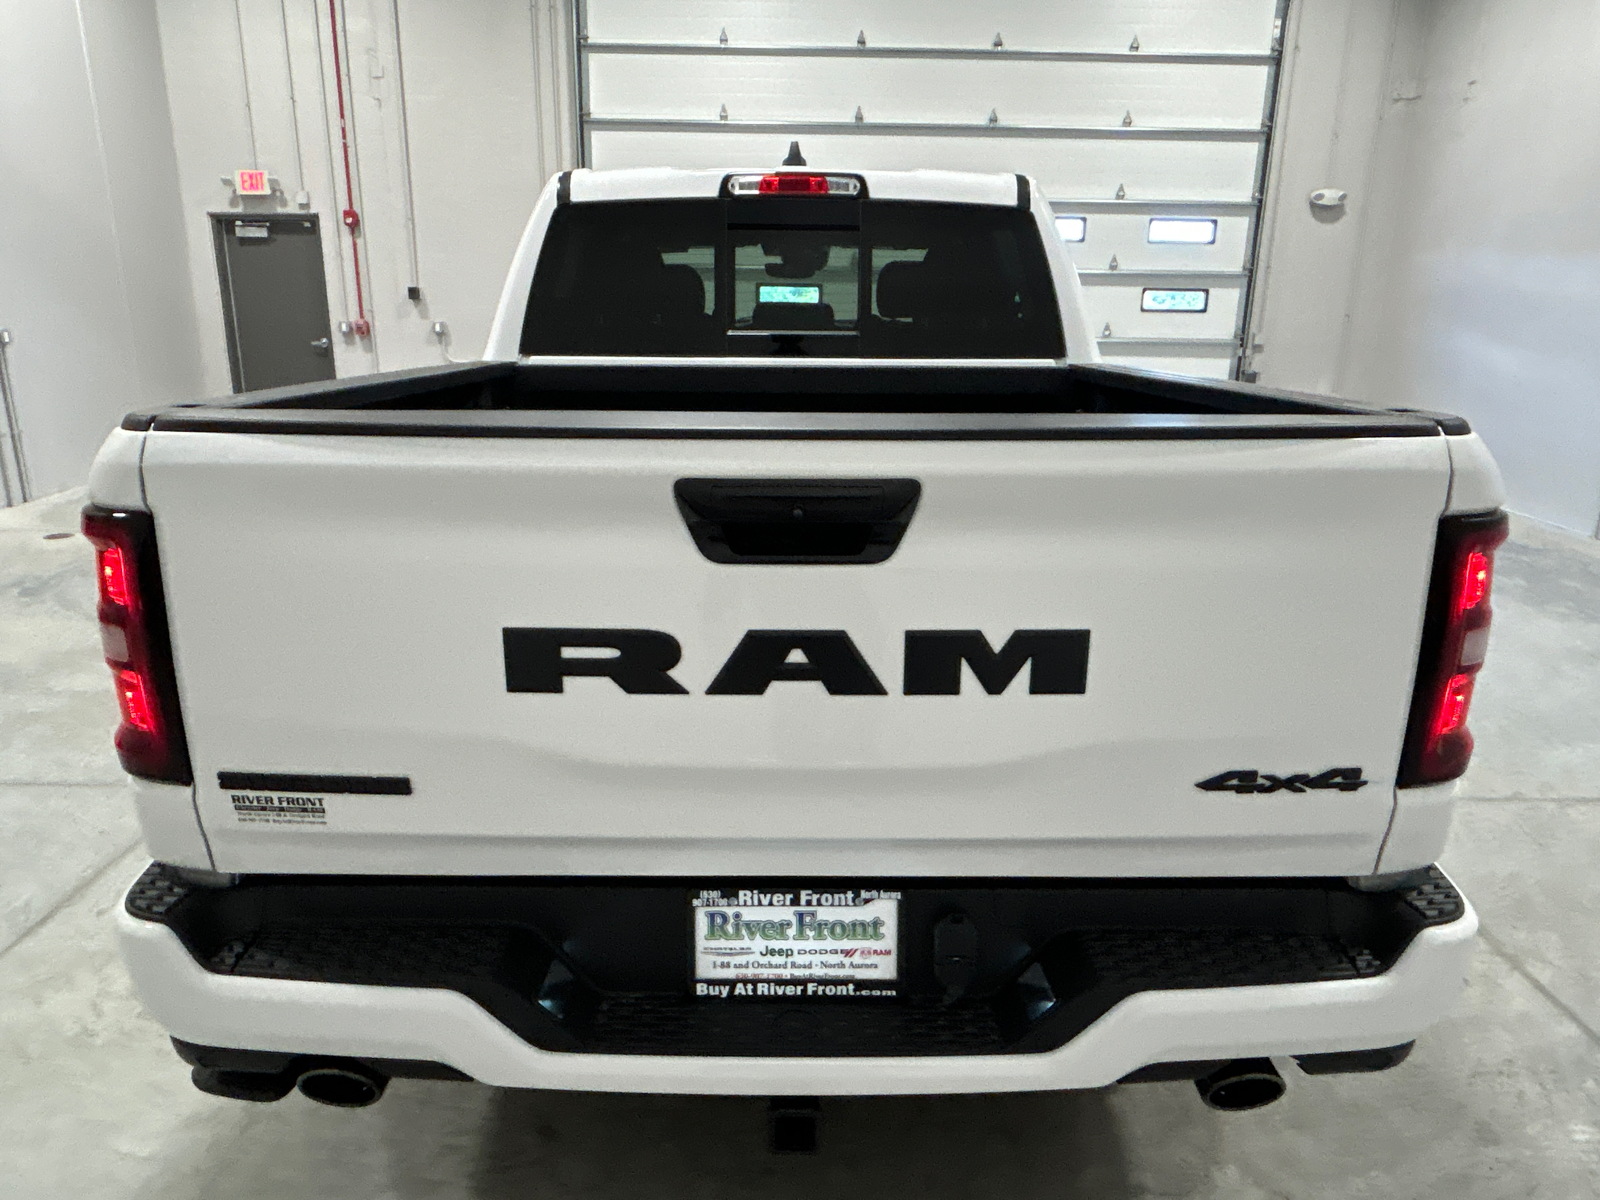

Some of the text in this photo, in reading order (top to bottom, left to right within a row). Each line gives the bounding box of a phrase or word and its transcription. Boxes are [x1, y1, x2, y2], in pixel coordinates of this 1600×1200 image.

[240, 171, 264, 191] EXIT
[502, 627, 1091, 695] RAM
[1194, 767, 1368, 794] 4x4
[231, 794, 325, 807] RIVER FRONT
[738, 890, 854, 906] River Front
[704, 910, 885, 941] River Front
[759, 945, 794, 958] Jeep
[733, 961, 749, 969] and
[752, 961, 787, 969] Orchard
[790, 961, 813, 969] Road
[820, 961, 846, 969] North
[848, 961, 878, 969] Aurora
[696, 983, 730, 997] Buy
[733, 983, 754, 996] At
[757, 983, 803, 996] River
